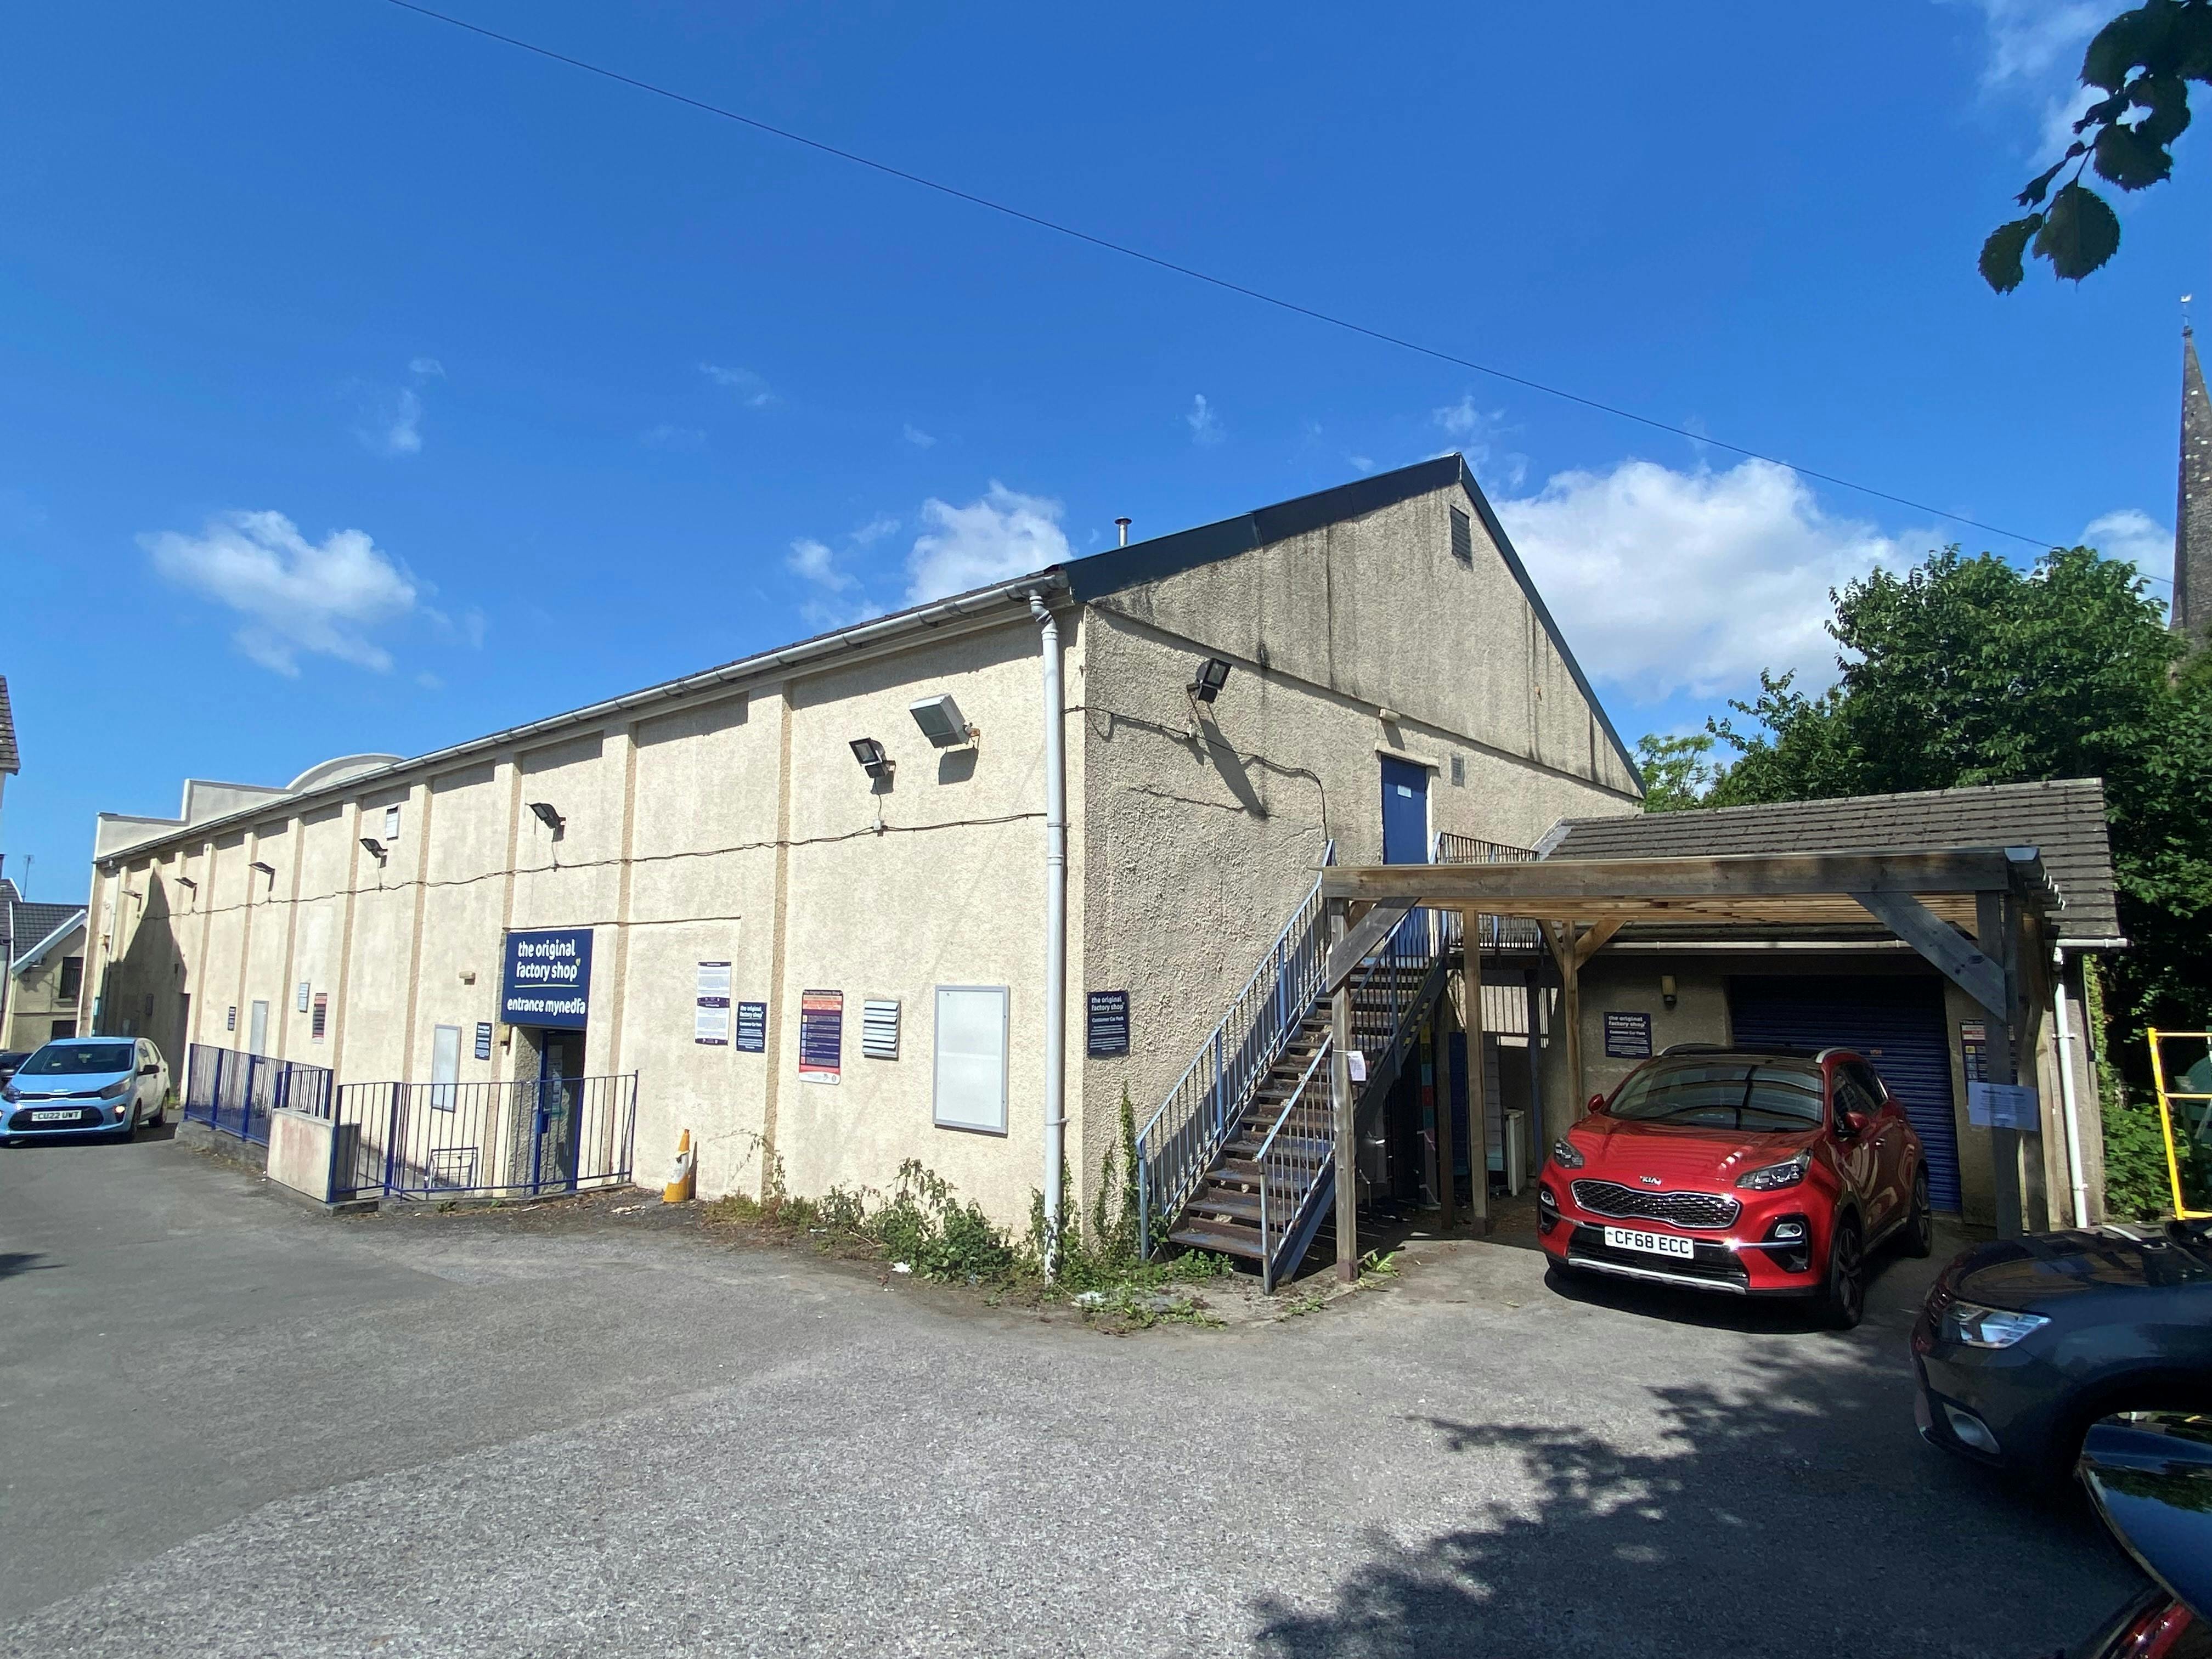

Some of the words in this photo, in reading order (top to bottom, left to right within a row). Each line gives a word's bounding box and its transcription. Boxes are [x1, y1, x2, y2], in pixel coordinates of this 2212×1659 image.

[518, 940, 534, 957] the
[535, 939, 576, 961] original
[516, 961, 550, 982] factory
[551, 961, 578, 982] shop
[507, 997, 544, 1012] entrance
[545, 997, 586, 1016] mynedfa
[1101, 996, 1122, 1004] original
[1641, 1176, 1658, 1184] KIA
[1615, 1230, 1654, 1249] CF68
[1658, 1236, 1689, 1254] ECC
